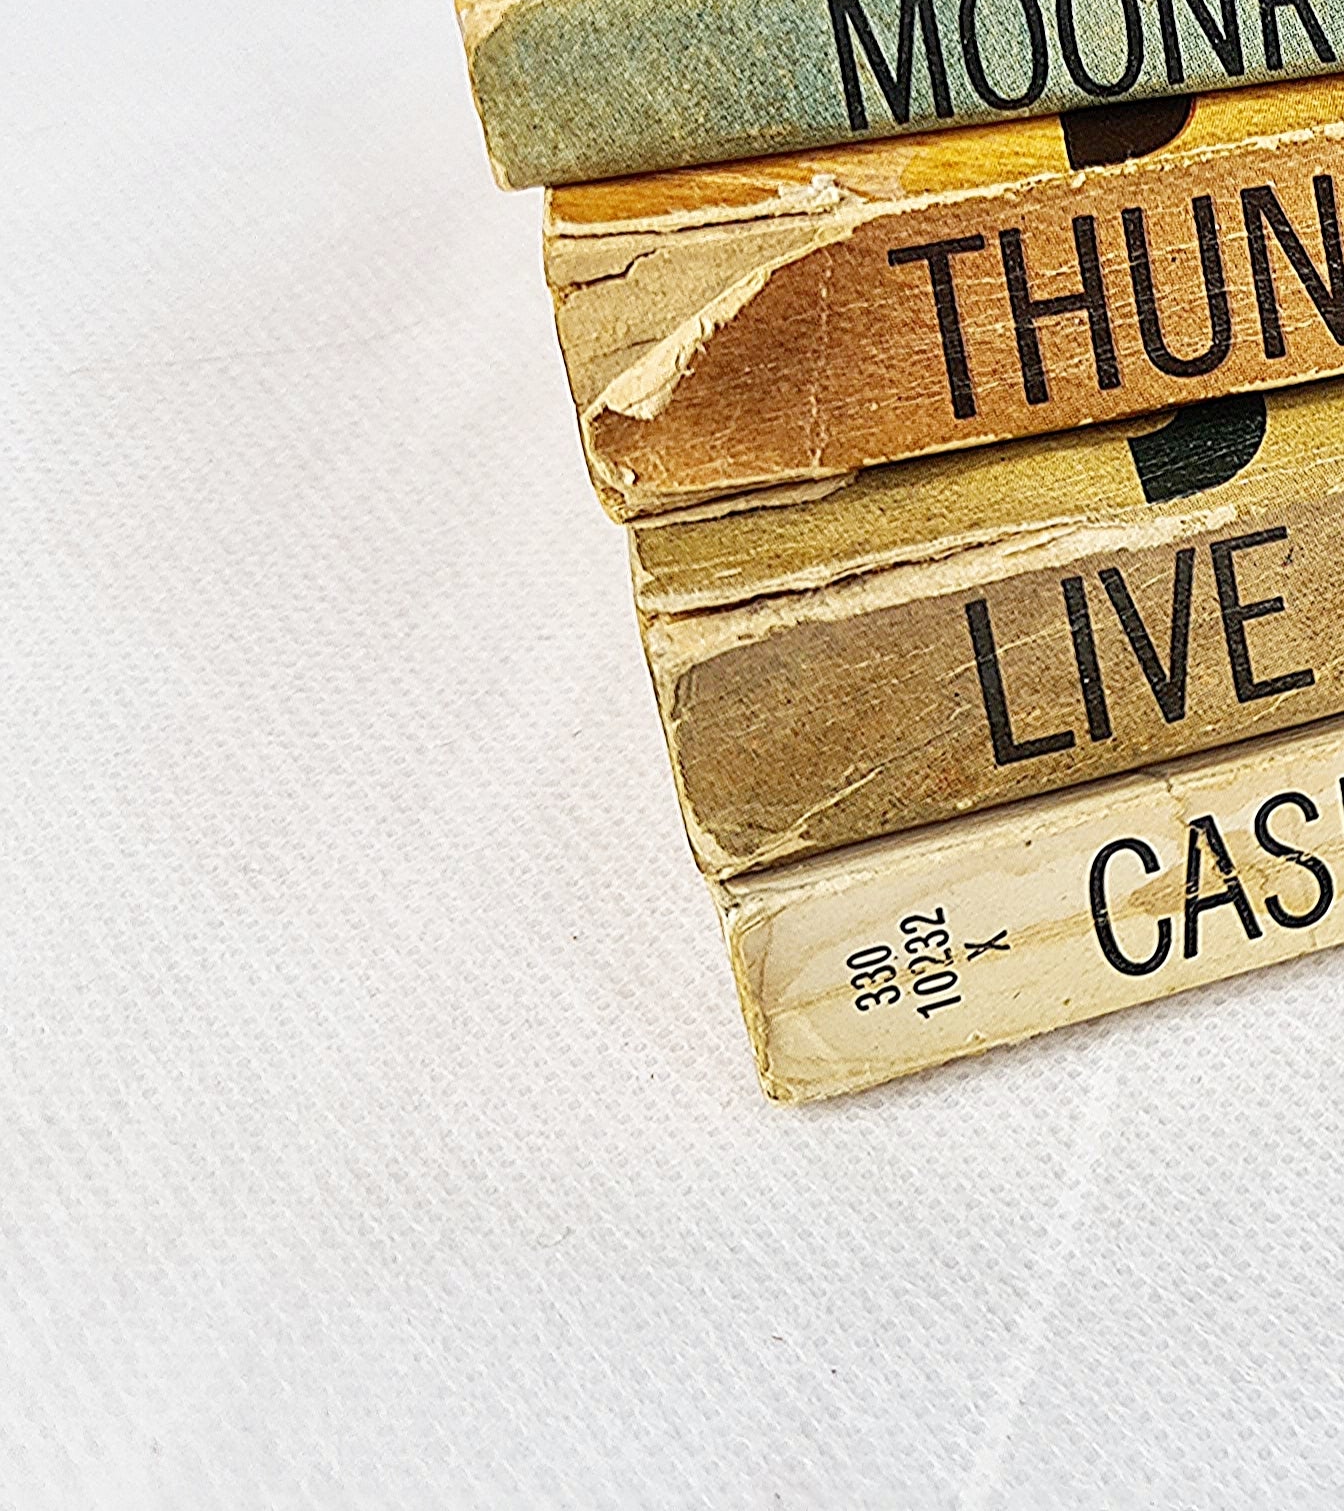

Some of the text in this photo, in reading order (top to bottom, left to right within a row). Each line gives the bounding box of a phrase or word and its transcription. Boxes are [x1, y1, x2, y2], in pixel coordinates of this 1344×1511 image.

[964, 526, 1316, 767] LIVE
[845, 943, 902, 1013] 330
[900, 906, 963, 1020] 10232
[964, 928, 1011, 962] X
